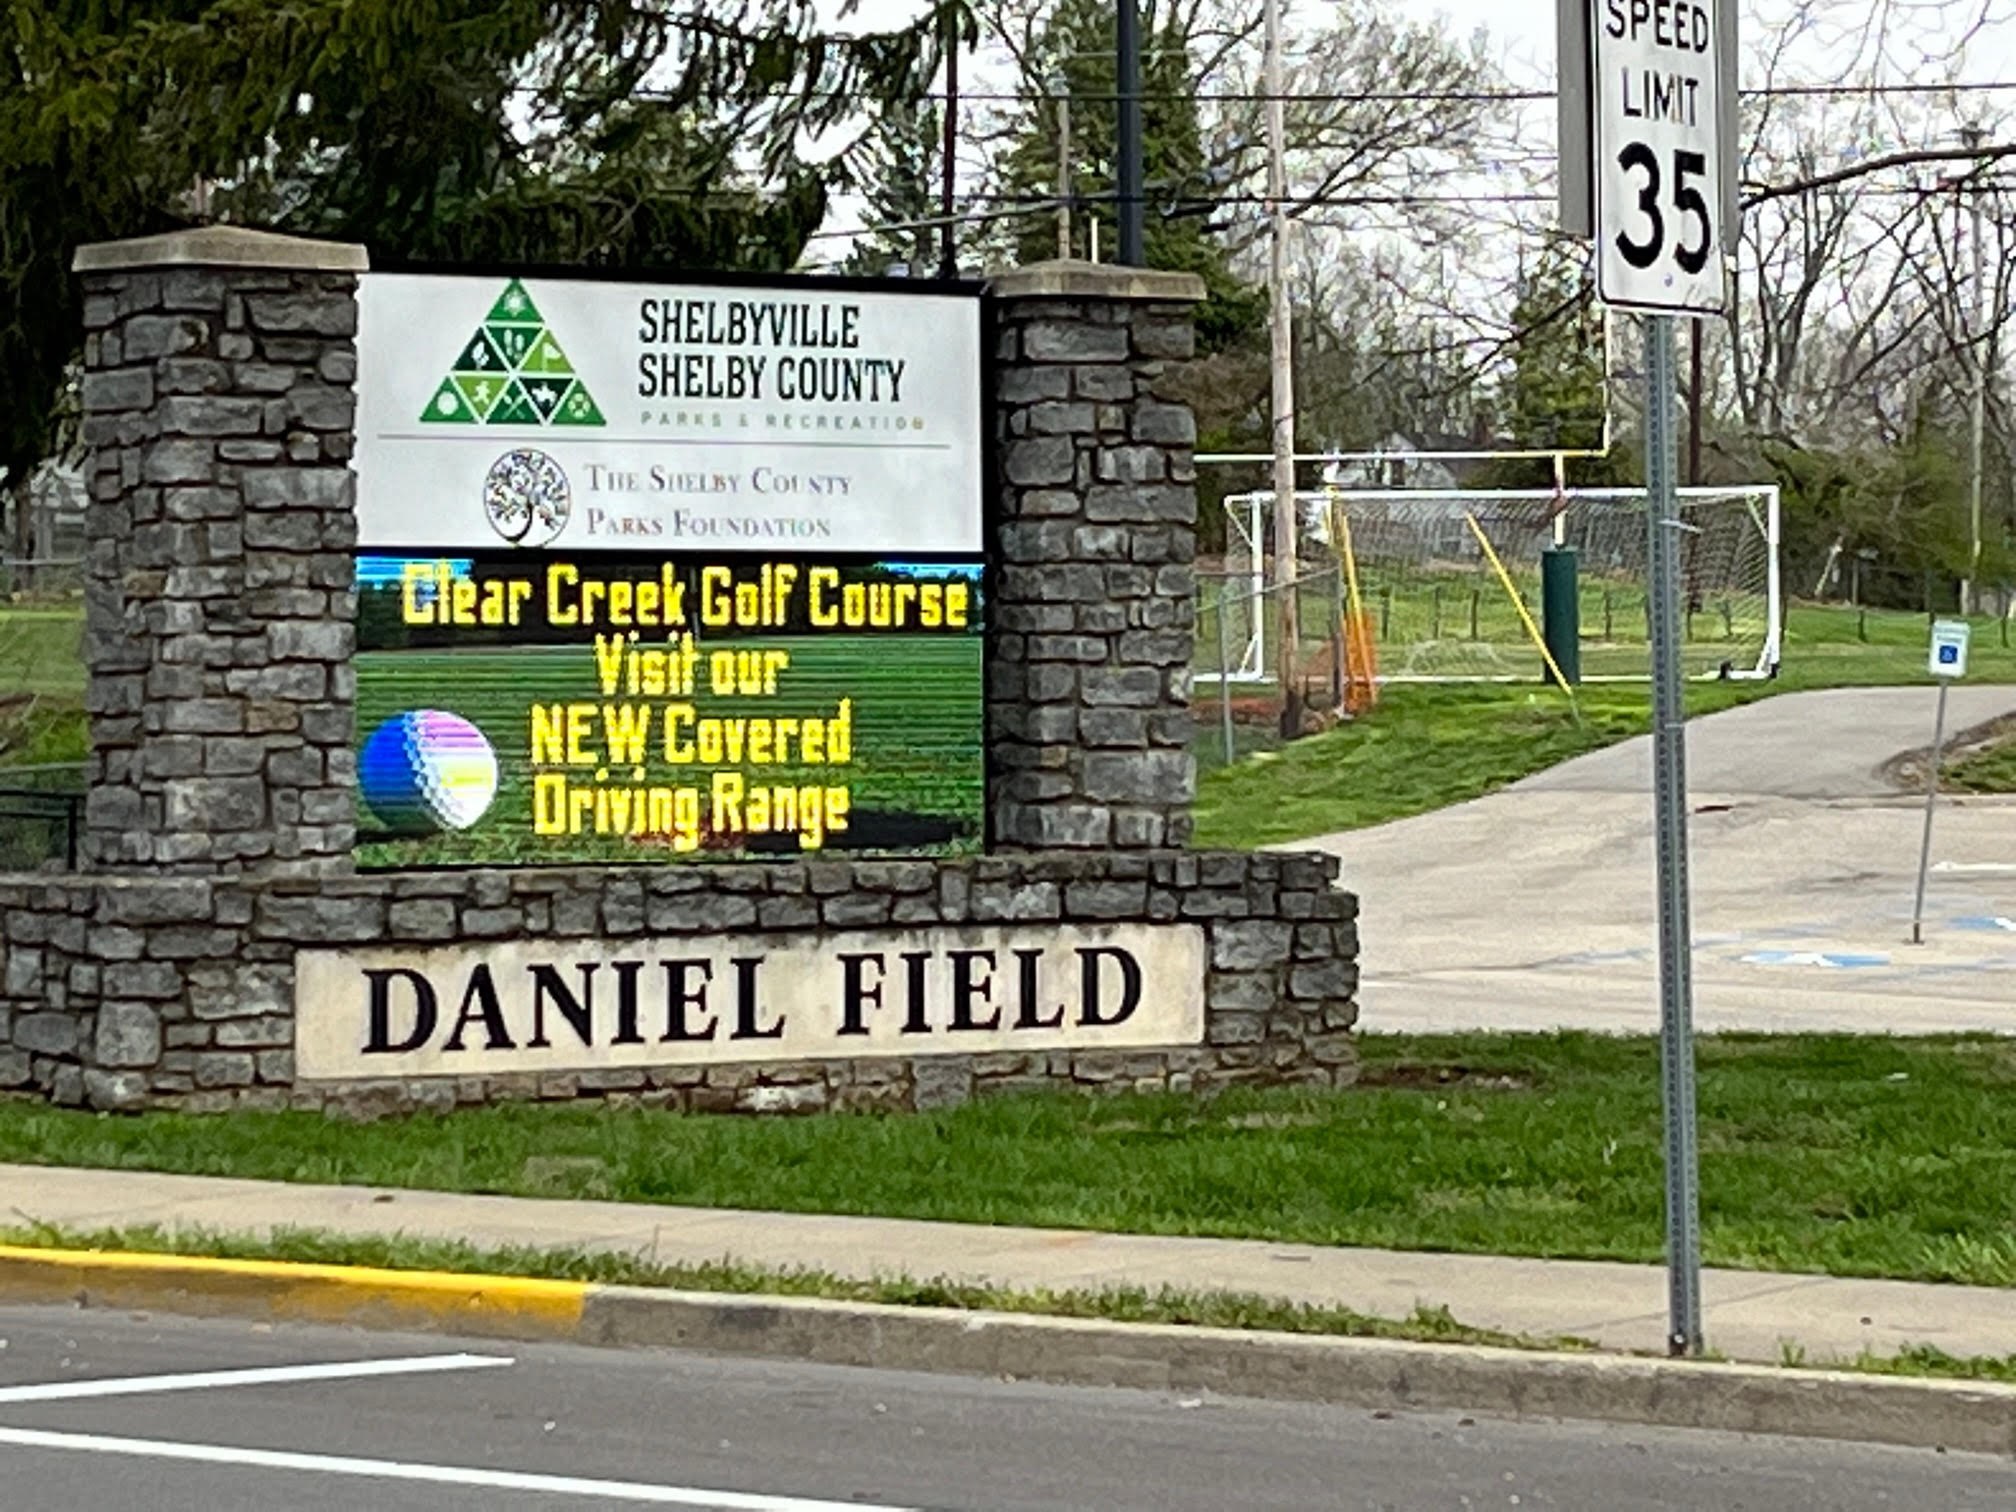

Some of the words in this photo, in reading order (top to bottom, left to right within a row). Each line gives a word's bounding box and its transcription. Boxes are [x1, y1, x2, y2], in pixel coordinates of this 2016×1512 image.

[1605, 0, 1708, 53] SPEED
[1622, 67, 1698, 126] LIMIT
[1615, 142, 1711, 274] 35
[639, 299, 859, 347] SHELBYVILLE
[638, 353, 766, 399] SHELBY
[777, 356, 904, 402] COUNTY
[641, 410, 721, 427] PARKS
[584, 464, 640, 492] THE
[650, 464, 740, 494] SHELBY
[752, 466, 851, 496] COUNTY
[587, 508, 664, 536] PARKS
[673, 509, 832, 538] FOUNDATION
[403, 558, 533, 626] Clear
[547, 562, 686, 626] Creek
[701, 565, 798, 628] Golf
[809, 568, 969, 628] Course
[595, 630, 700, 696] Visit
[711, 650, 790, 695] our
[530, 703, 651, 764] NEW
[664, 697, 852, 764] Covered
[532, 766, 699, 853] Driving
[712, 772, 850, 850] Range
[361, 955, 786, 1055] DANIEL
[837, 945, 1144, 1037] FIELD
